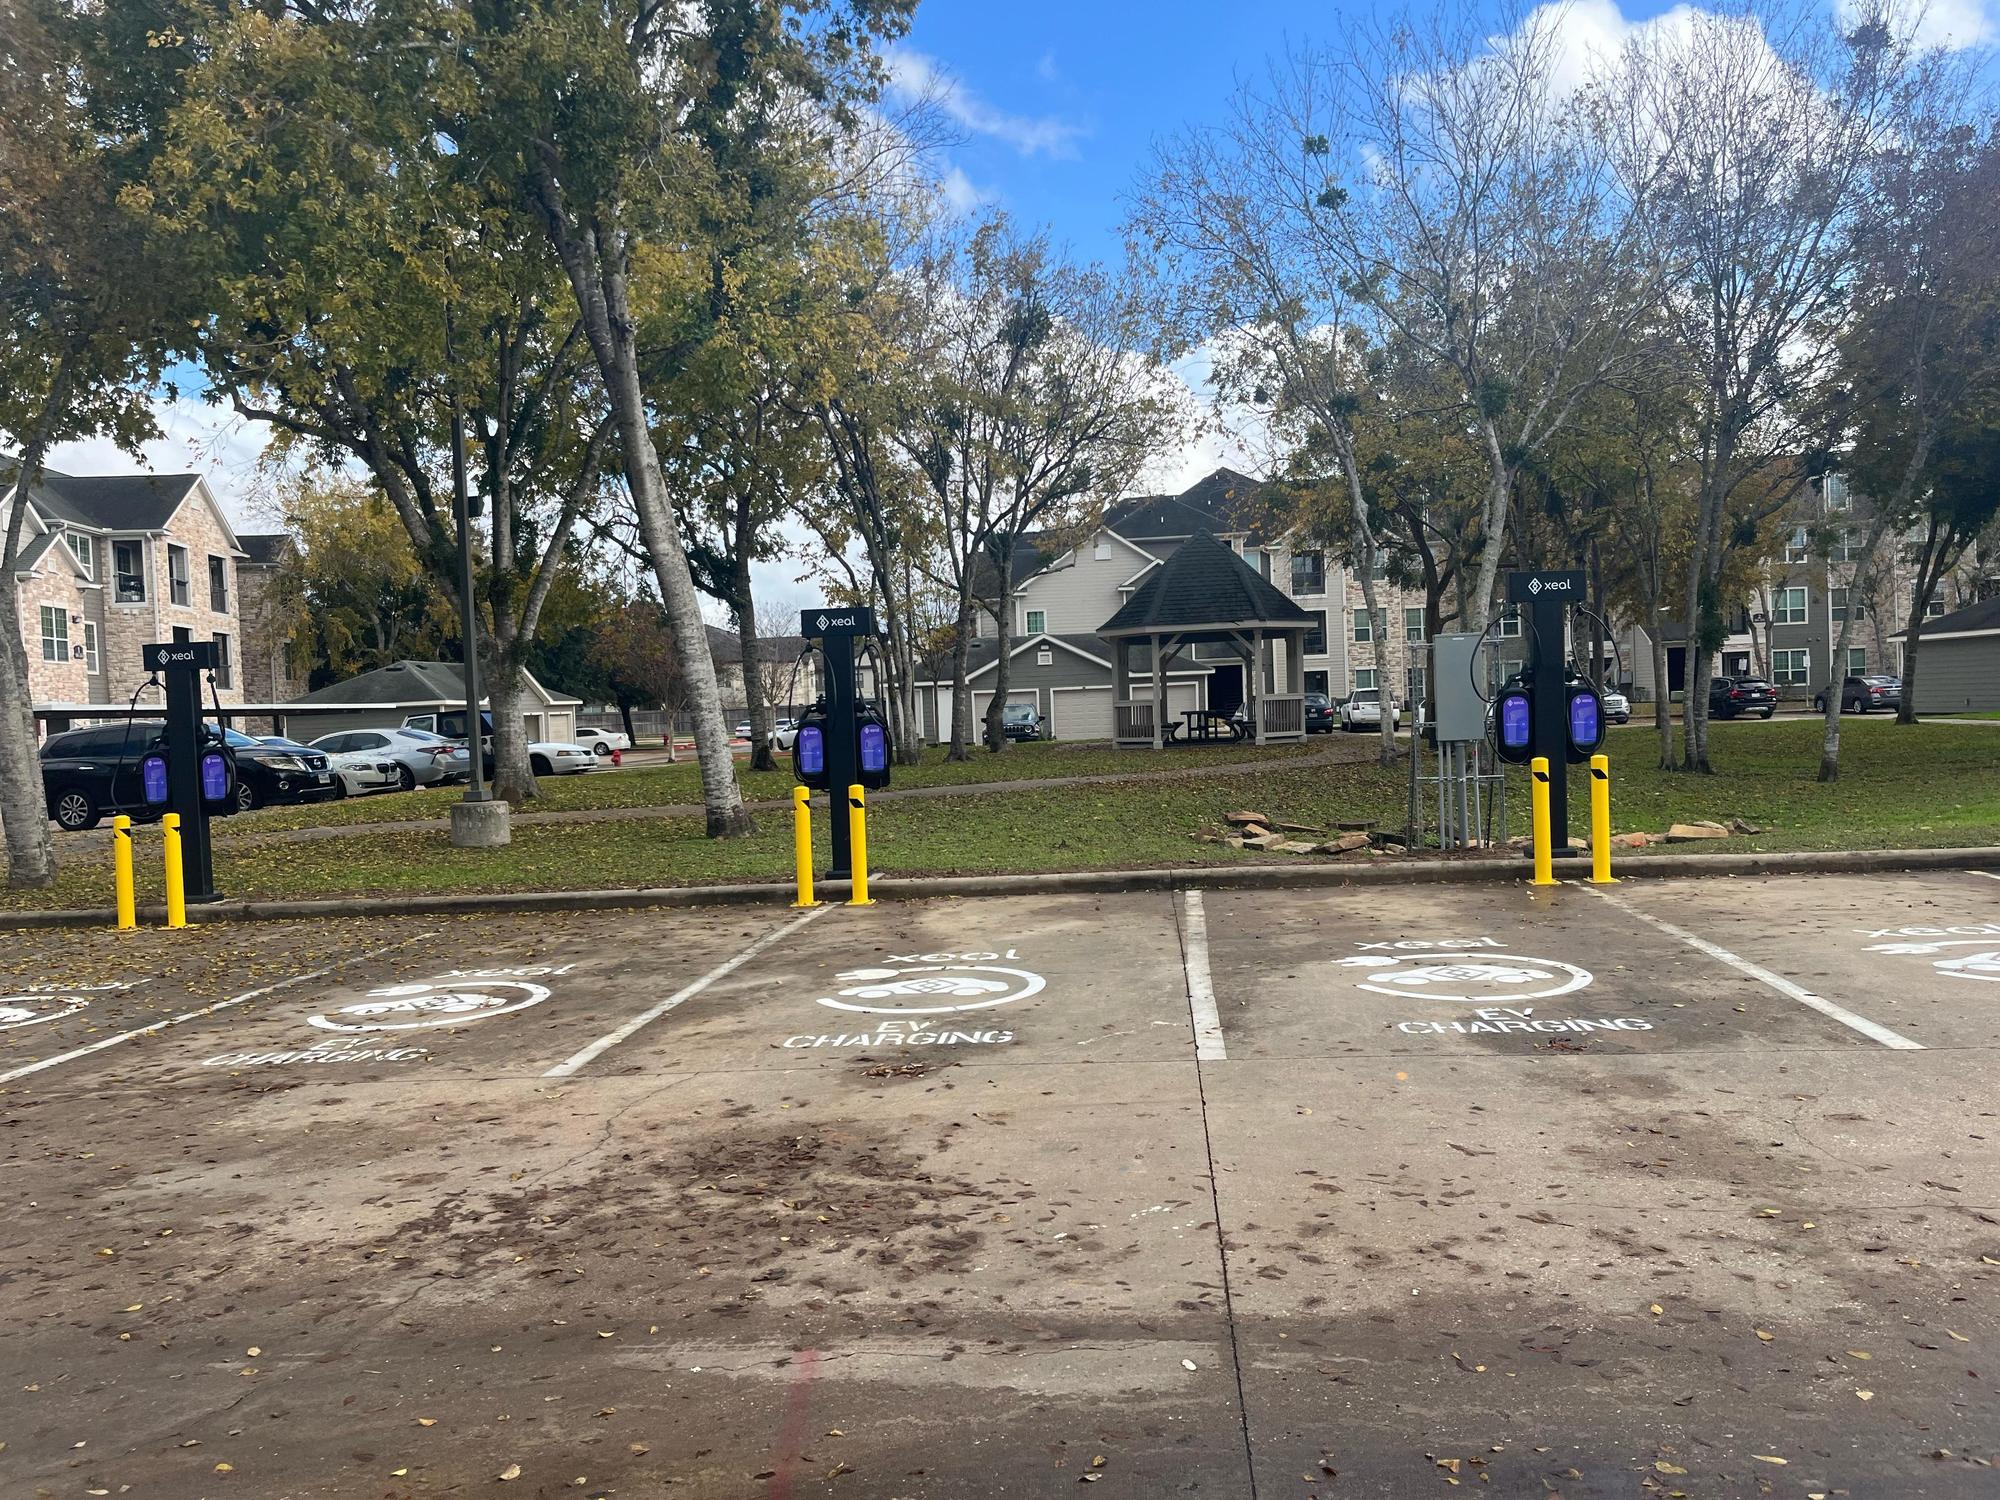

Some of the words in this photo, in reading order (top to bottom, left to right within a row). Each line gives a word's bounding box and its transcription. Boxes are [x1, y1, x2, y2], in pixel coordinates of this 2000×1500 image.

[1544, 578, 1572, 590] xeal
[831, 615, 856, 627] xeal
[171, 650, 195, 661] xeal
[1474, 1007, 1535, 1021] EV
[875, 1020, 937, 1033] EV
[1397, 1018, 1654, 1035] CHARGING
[308, 1037, 381, 1050] EV
[782, 1030, 1015, 1049] CHARGING
[201, 1048, 429, 1066] CHARGING
